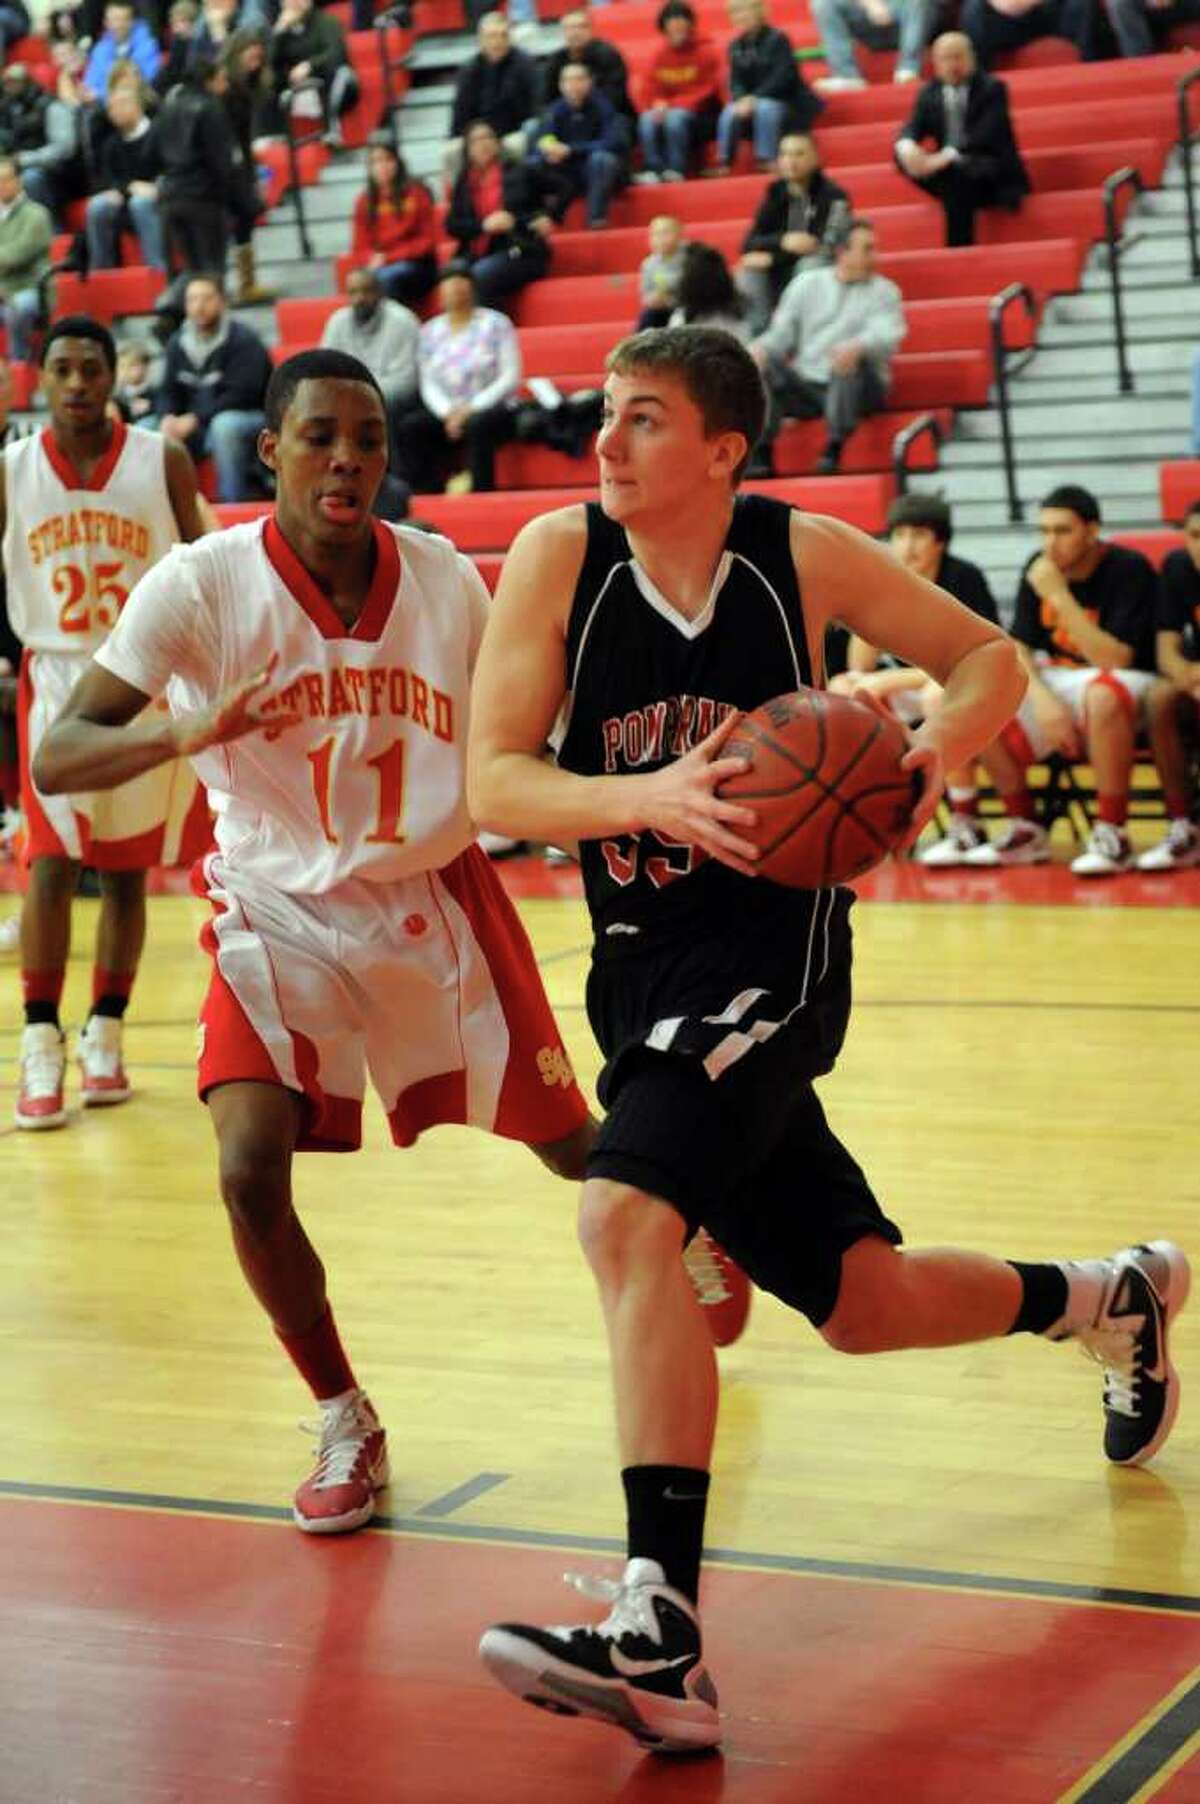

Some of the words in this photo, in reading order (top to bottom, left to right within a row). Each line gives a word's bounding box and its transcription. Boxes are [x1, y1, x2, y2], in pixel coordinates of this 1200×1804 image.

[27, 508, 151, 566] STRATFORD
[51, 562, 129, 635] 25
[306, 735, 405, 843] 11
